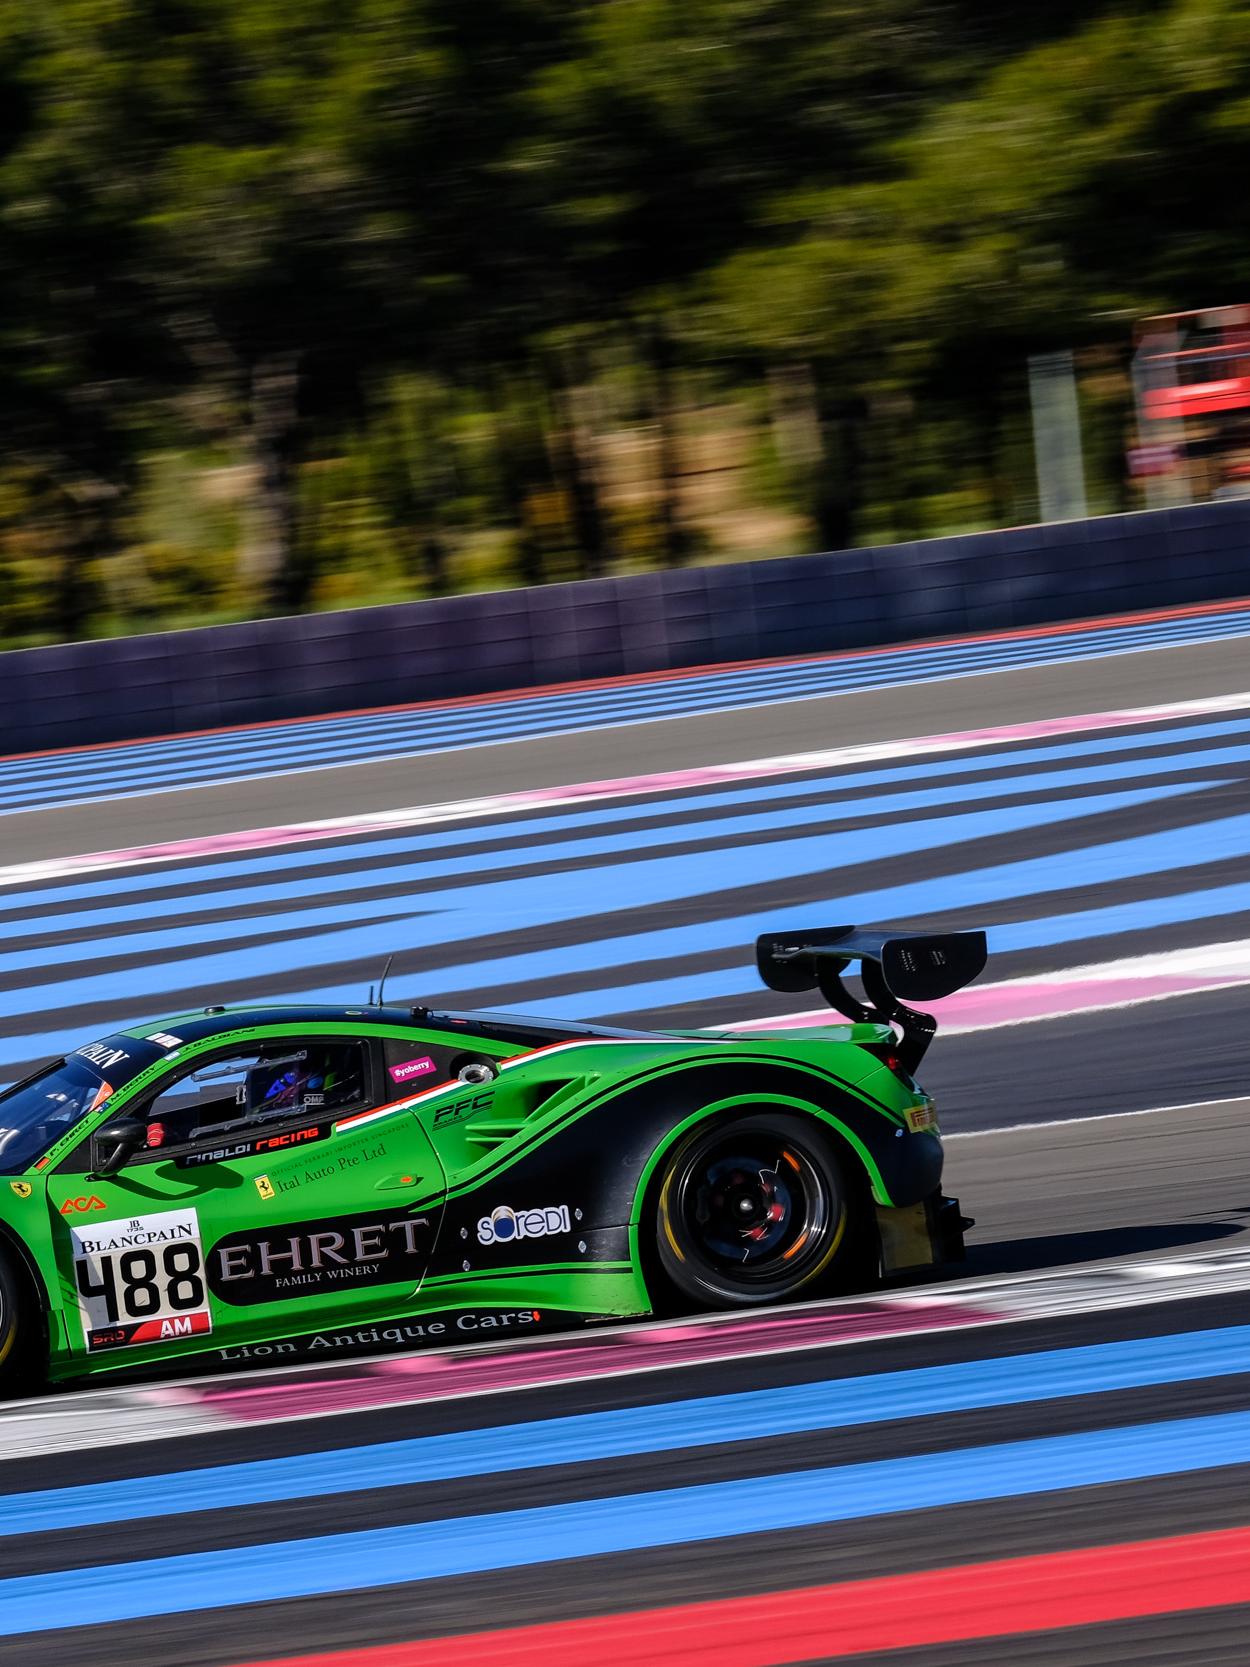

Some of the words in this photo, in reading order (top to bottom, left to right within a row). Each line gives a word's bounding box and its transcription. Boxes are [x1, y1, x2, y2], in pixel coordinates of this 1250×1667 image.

[434, 1091, 496, 1123] PFC
[271, 1162, 302, 1177] OFFICIAL
[305, 1150, 333, 1165] FERRARI
[335, 1138, 369, 1153] IMPORTER
[371, 1122, 410, 1140] SINGAPORE
[276, 1175, 301, 1193] Ital
[304, 1166, 335, 1184] Auto
[337, 1156, 361, 1171] Pte
[361, 1143, 387, 1162] Ltd
[80, 1223, 193, 1254] BLANCPAIN
[217, 1218, 430, 1282] EHRET
[76, 1242, 204, 1323] 488
[275, 1273, 323, 1288] FAMILY
[326, 1263, 381, 1279] WINERY
[160, 1317, 192, 1338] AM
[218, 1342, 298, 1361] Lion
[301, 1322, 447, 1350] Antique
[456, 1310, 534, 1331] Cars
